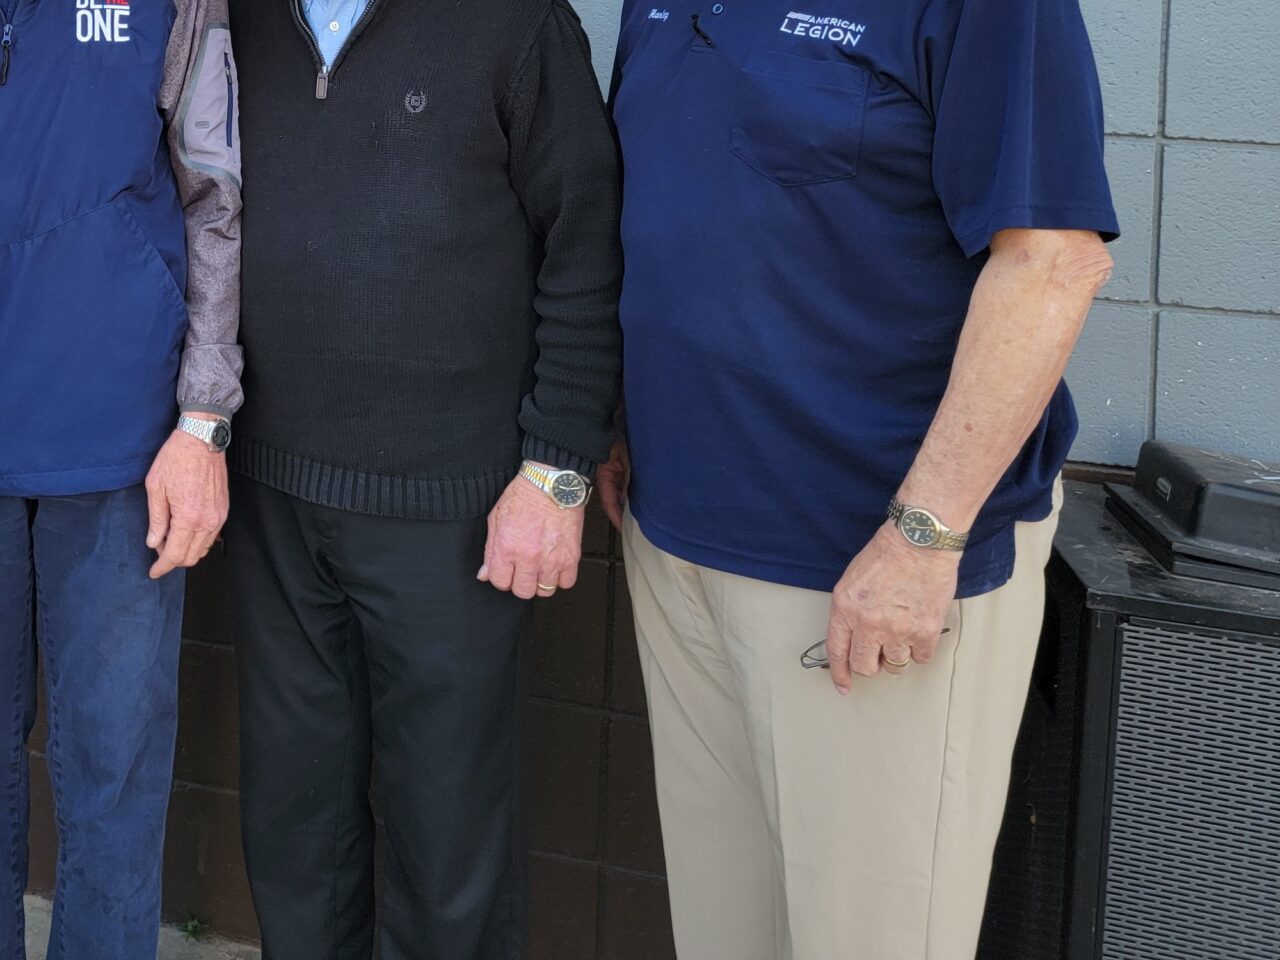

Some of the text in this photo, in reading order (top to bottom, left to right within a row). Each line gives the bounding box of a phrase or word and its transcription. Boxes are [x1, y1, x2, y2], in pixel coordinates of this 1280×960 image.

[76, 9, 130, 42] ONE
[780, 18, 861, 47] LEGION
[808, 16, 866, 33] AMERICAN
